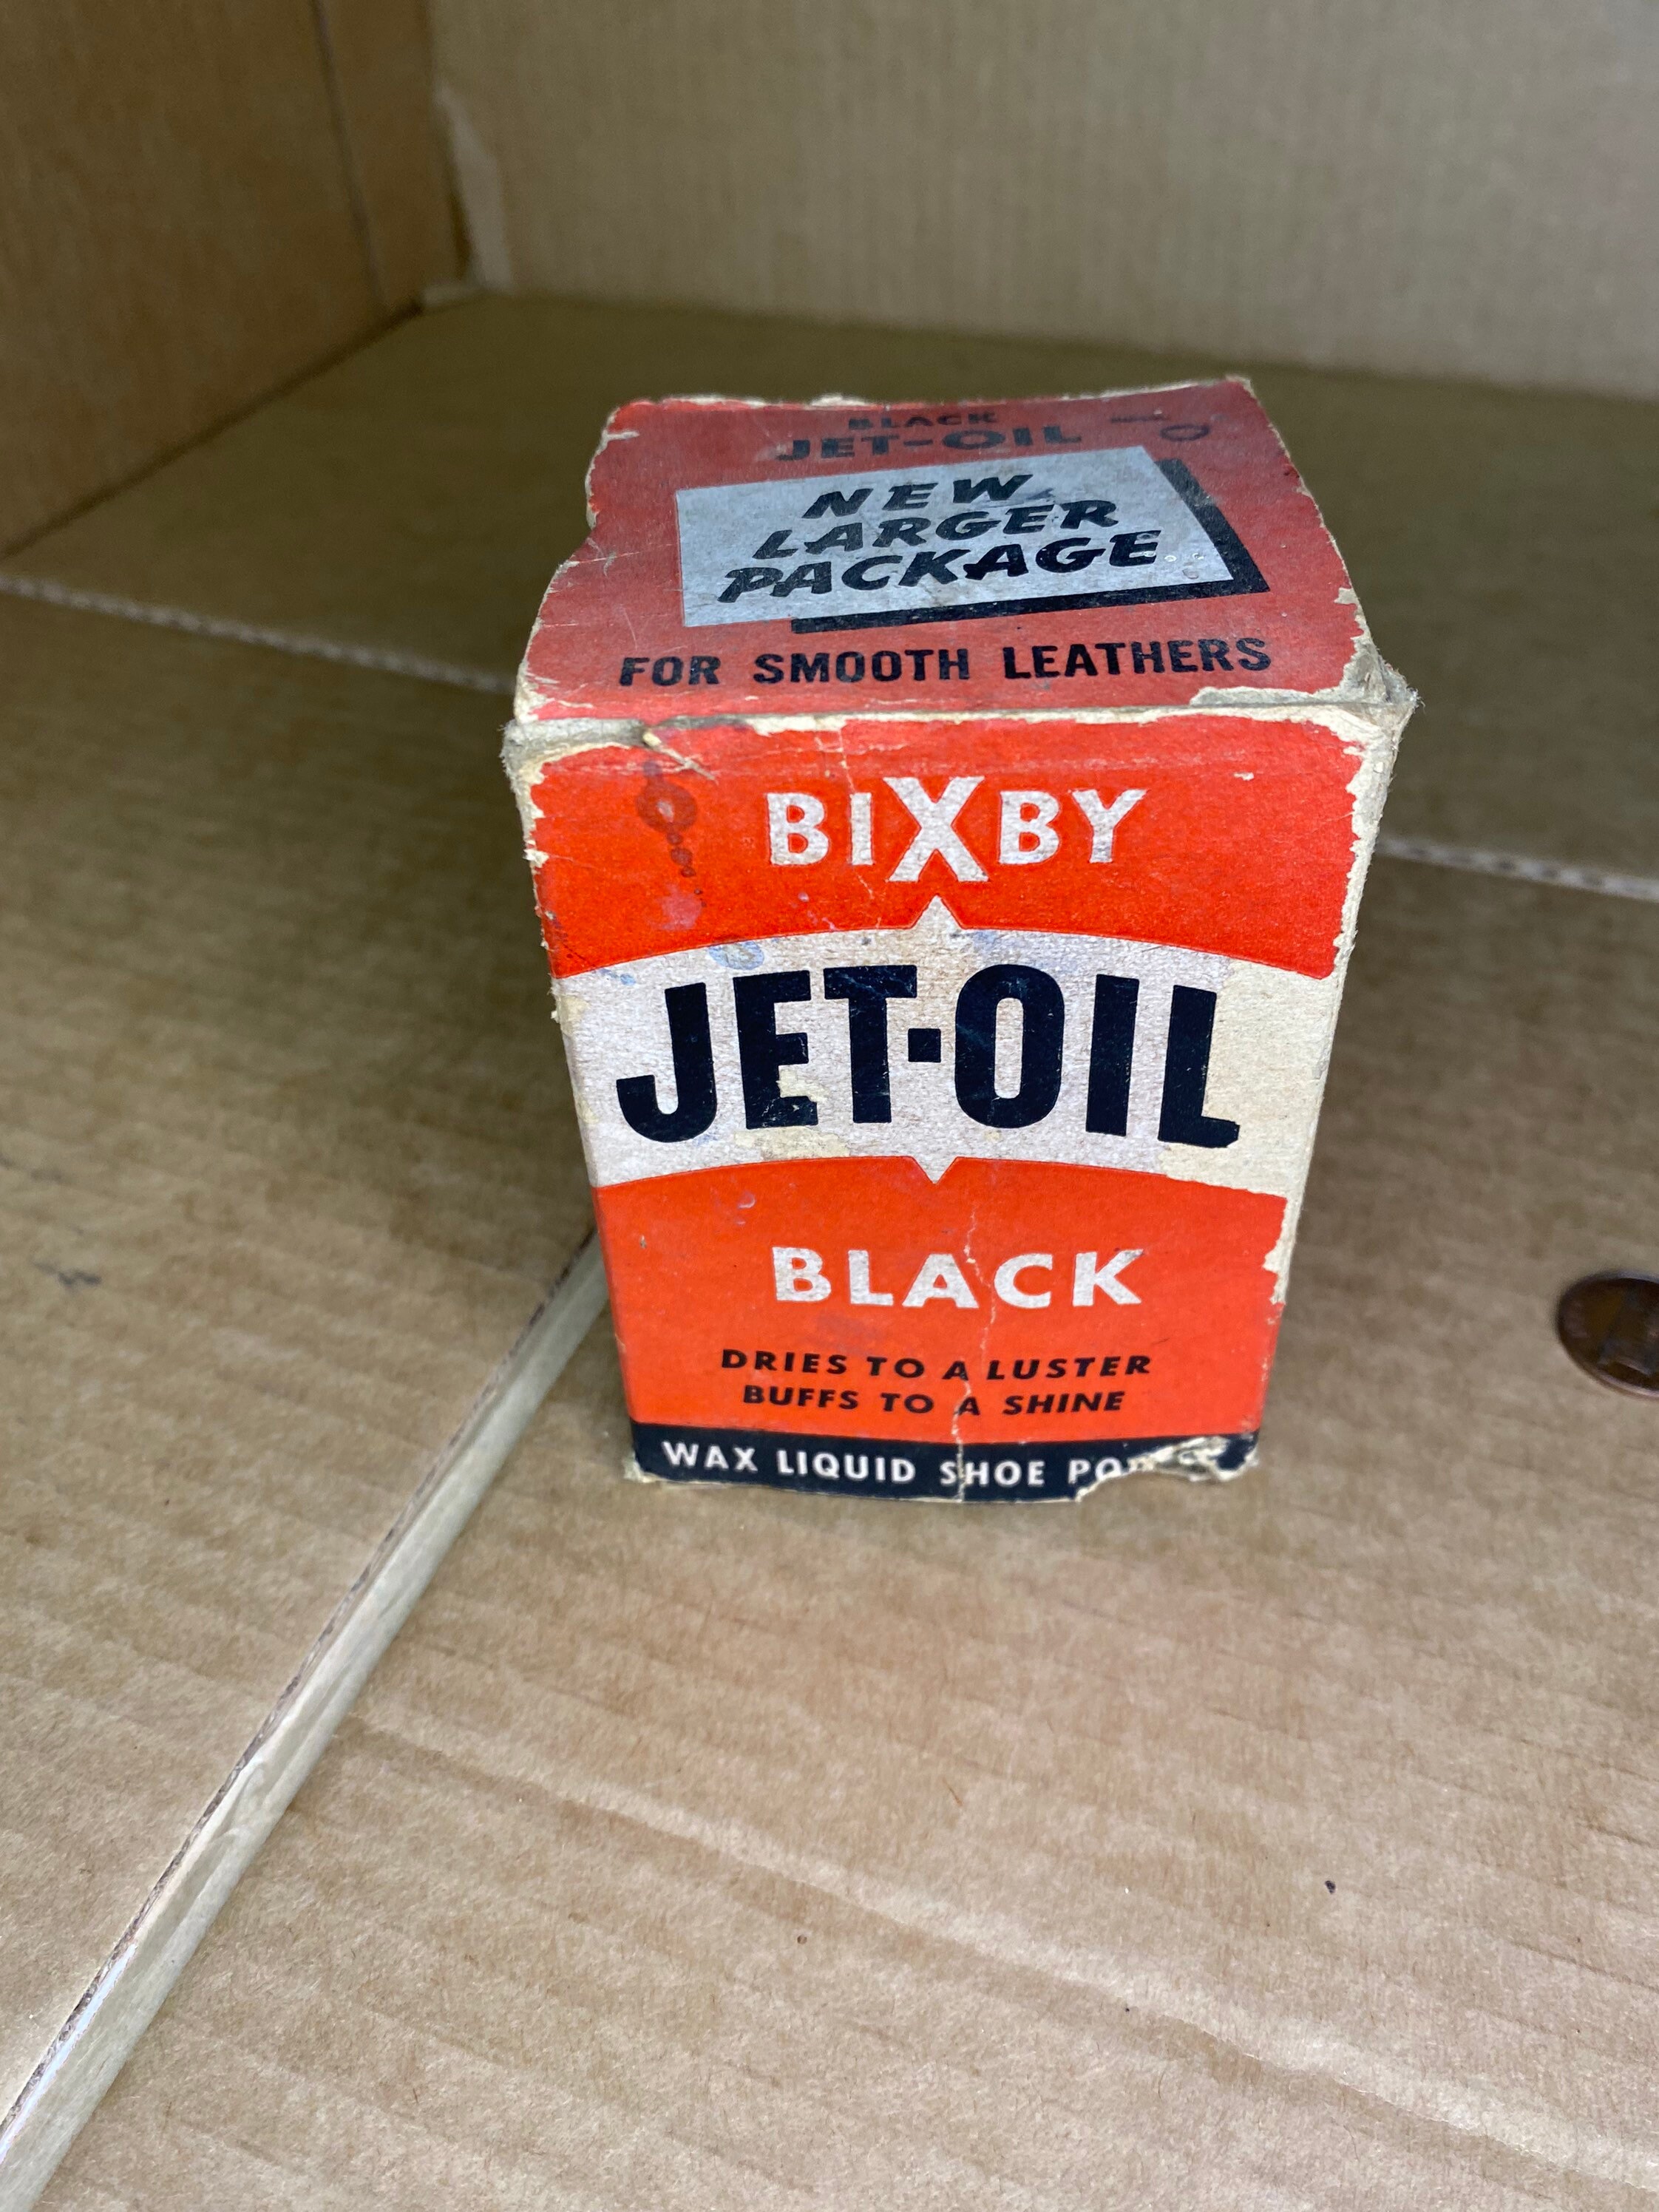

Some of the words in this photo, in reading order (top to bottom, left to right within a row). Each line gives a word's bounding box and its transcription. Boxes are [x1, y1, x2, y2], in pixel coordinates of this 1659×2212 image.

[776, 424, 1082, 462] JET-OIL
[847, 410, 998, 430] BLACK
[801, 473, 1036, 520] NEW
[751, 498, 1119, 560] LARGER
[716, 529, 1162, 603] PACKAGE
[618, 654, 722, 688] FOR
[753, 647, 971, 685] SMOOTH
[1002, 637, 1272, 680] LEATHERS
[766, 775, 1147, 883] BIXBY
[771, 1245, 1144, 1309] BLACK
[721, 1348, 847, 1375] DRIES
[866, 1356, 925, 1379] TO
[942, 1360, 969, 1382] A
[986, 1354, 1153, 1381] LUSTER
[742, 1385, 858, 1410] BUFFS
[881, 1392, 934, 1414] TO
[957, 1397, 980, 1416] A
[1002, 1391, 1125, 1415] SHINE
[663, 1441, 759, 1471] WAX
[777, 1449, 916, 1482] LIQUID
[940, 1459, 1045, 1486] SHOE
